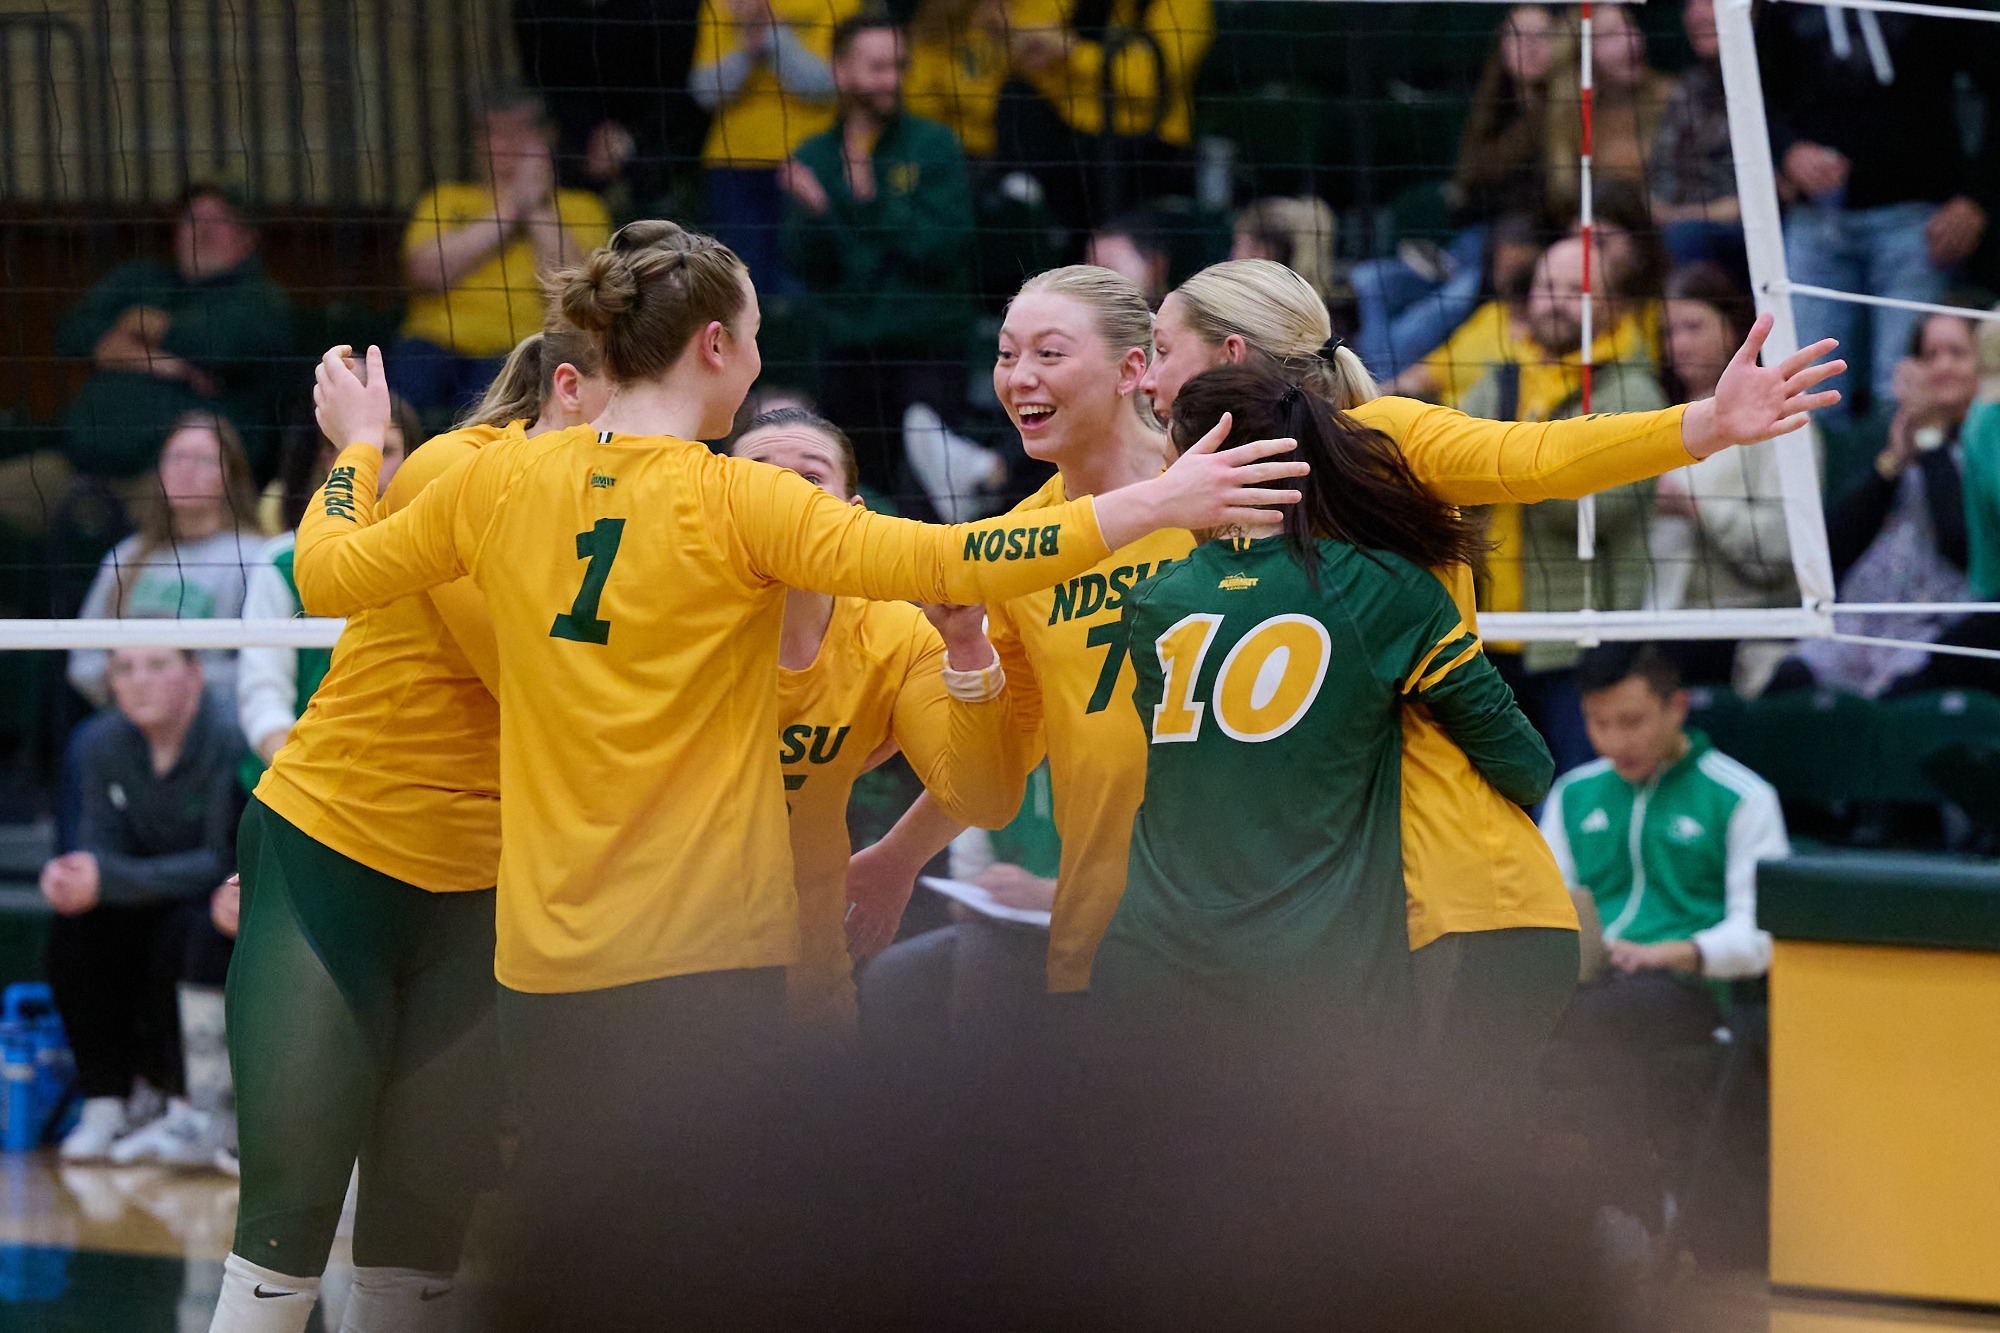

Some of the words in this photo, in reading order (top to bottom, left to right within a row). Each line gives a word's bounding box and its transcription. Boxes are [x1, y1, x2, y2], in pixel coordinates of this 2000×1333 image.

[324, 466, 357, 522] PRIDE
[549, 518, 626, 645] 1
[963, 524, 1061, 562] BISON
[1086, 621, 1128, 714] 7
[1151, 612, 1332, 744] 10
